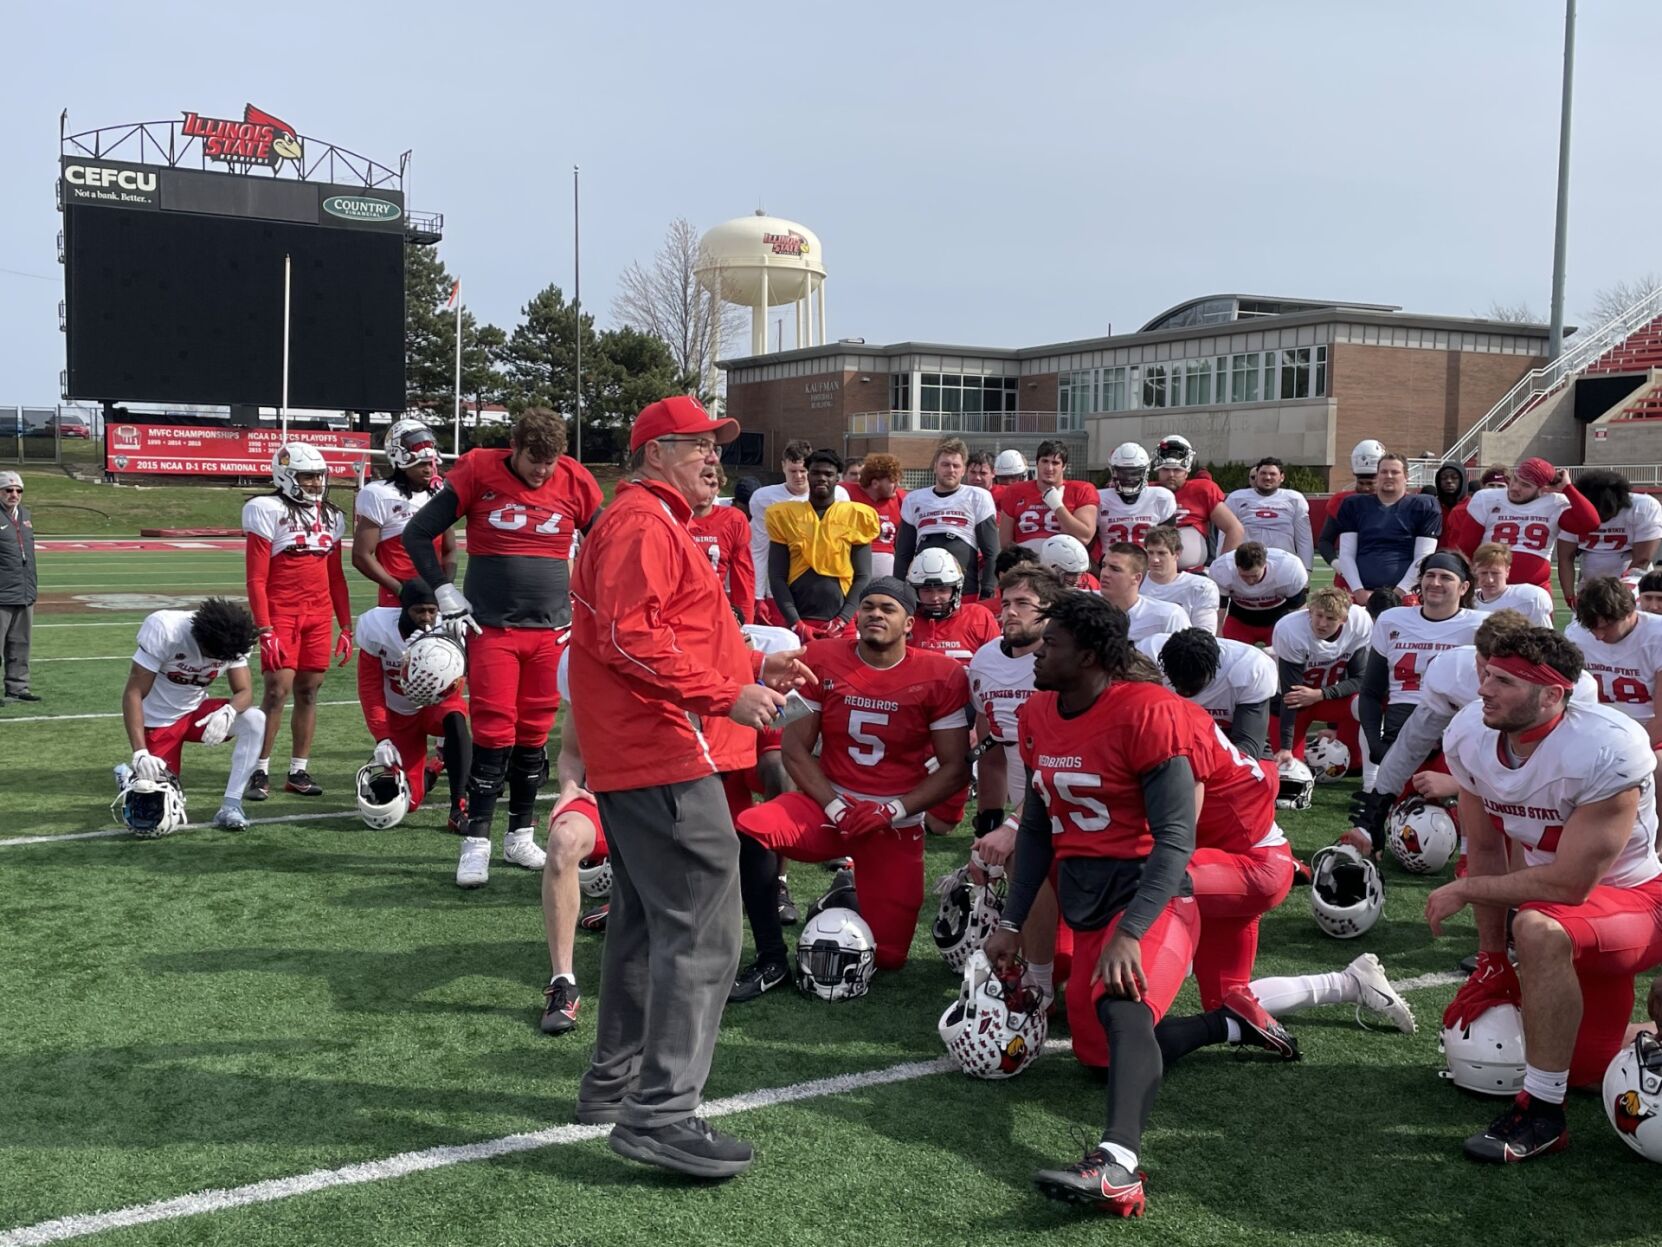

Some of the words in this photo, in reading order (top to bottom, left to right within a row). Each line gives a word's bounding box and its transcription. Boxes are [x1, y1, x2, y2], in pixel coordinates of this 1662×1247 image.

[183, 113, 274, 142] ILLINOIS
[205, 136, 271, 158] STATE
[65, 165, 157, 191] CEFCU
[74, 188, 91, 198] Not
[97, 190, 119, 200] bank.
[334, 199, 391, 214] COUNTRY
[148, 428, 172, 438] MVFC
[173, 430, 240, 440] CHAMPIONSHIPS
[248, 432, 269, 441] NCAA
[301, 434, 338, 443] PLAYOFFS
[136, 461, 157, 470] 2015
[160, 462, 183, 471] NCAA
[186, 462, 199, 471] D-1
[202, 463, 217, 471] FCS
[220, 463, 258, 472] NATIONAL
[1491, 522, 1550, 550] 89
[1435, 643, 1457, 651] STA
[1584, 662, 1613, 673] LINOIS
[1614, 666, 1641, 677] STATE
[1015, 689, 1034, 699] STA
[844, 694, 899, 712] REDBIRDS
[1208, 708, 1230, 716] TATE
[847, 709, 889, 767] 5
[1484, 798, 1527, 818] LINOIS
